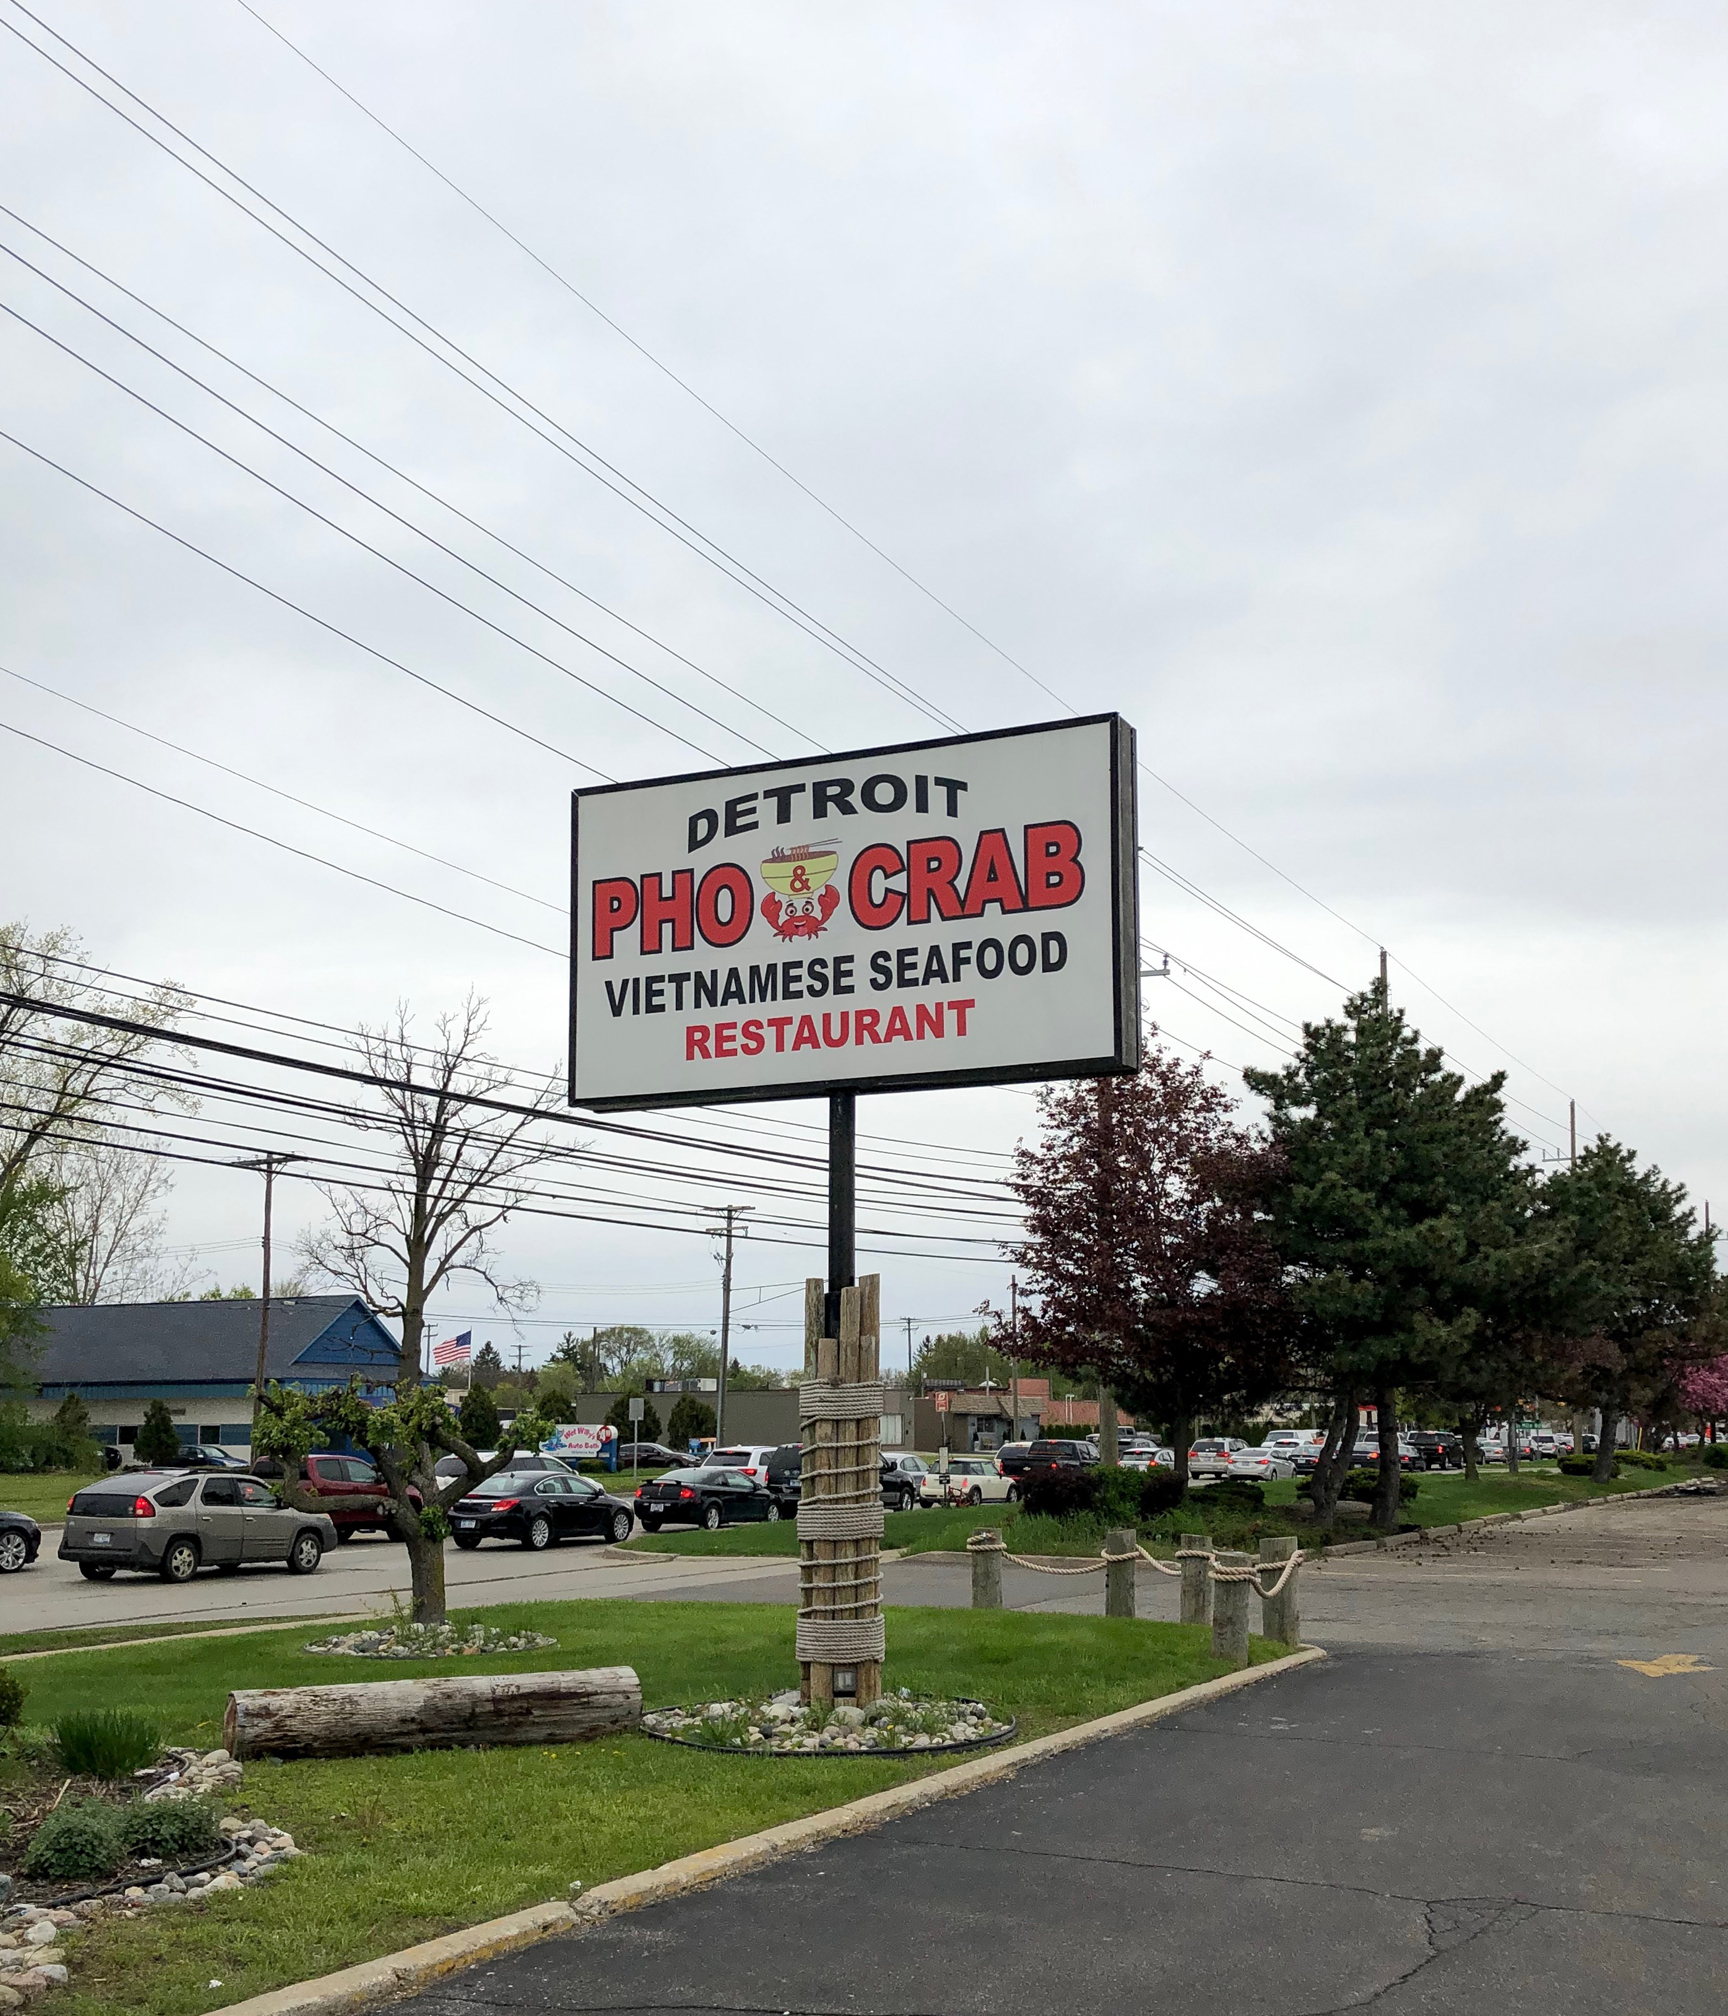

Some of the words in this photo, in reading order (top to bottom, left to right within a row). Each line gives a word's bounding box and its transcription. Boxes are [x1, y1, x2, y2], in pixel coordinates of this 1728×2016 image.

[688, 774, 968, 854] DETROIT
[591, 862, 754, 962] PHO
[790, 865, 811, 893] &
[848, 819, 1086, 931] CRAB
[605, 954, 855, 1018] VIETNAMESE
[870, 931, 1068, 991] SEAFOOD
[686, 998, 976, 1061] RESTAURANT
[564, 1428, 577, 1440] Wet
